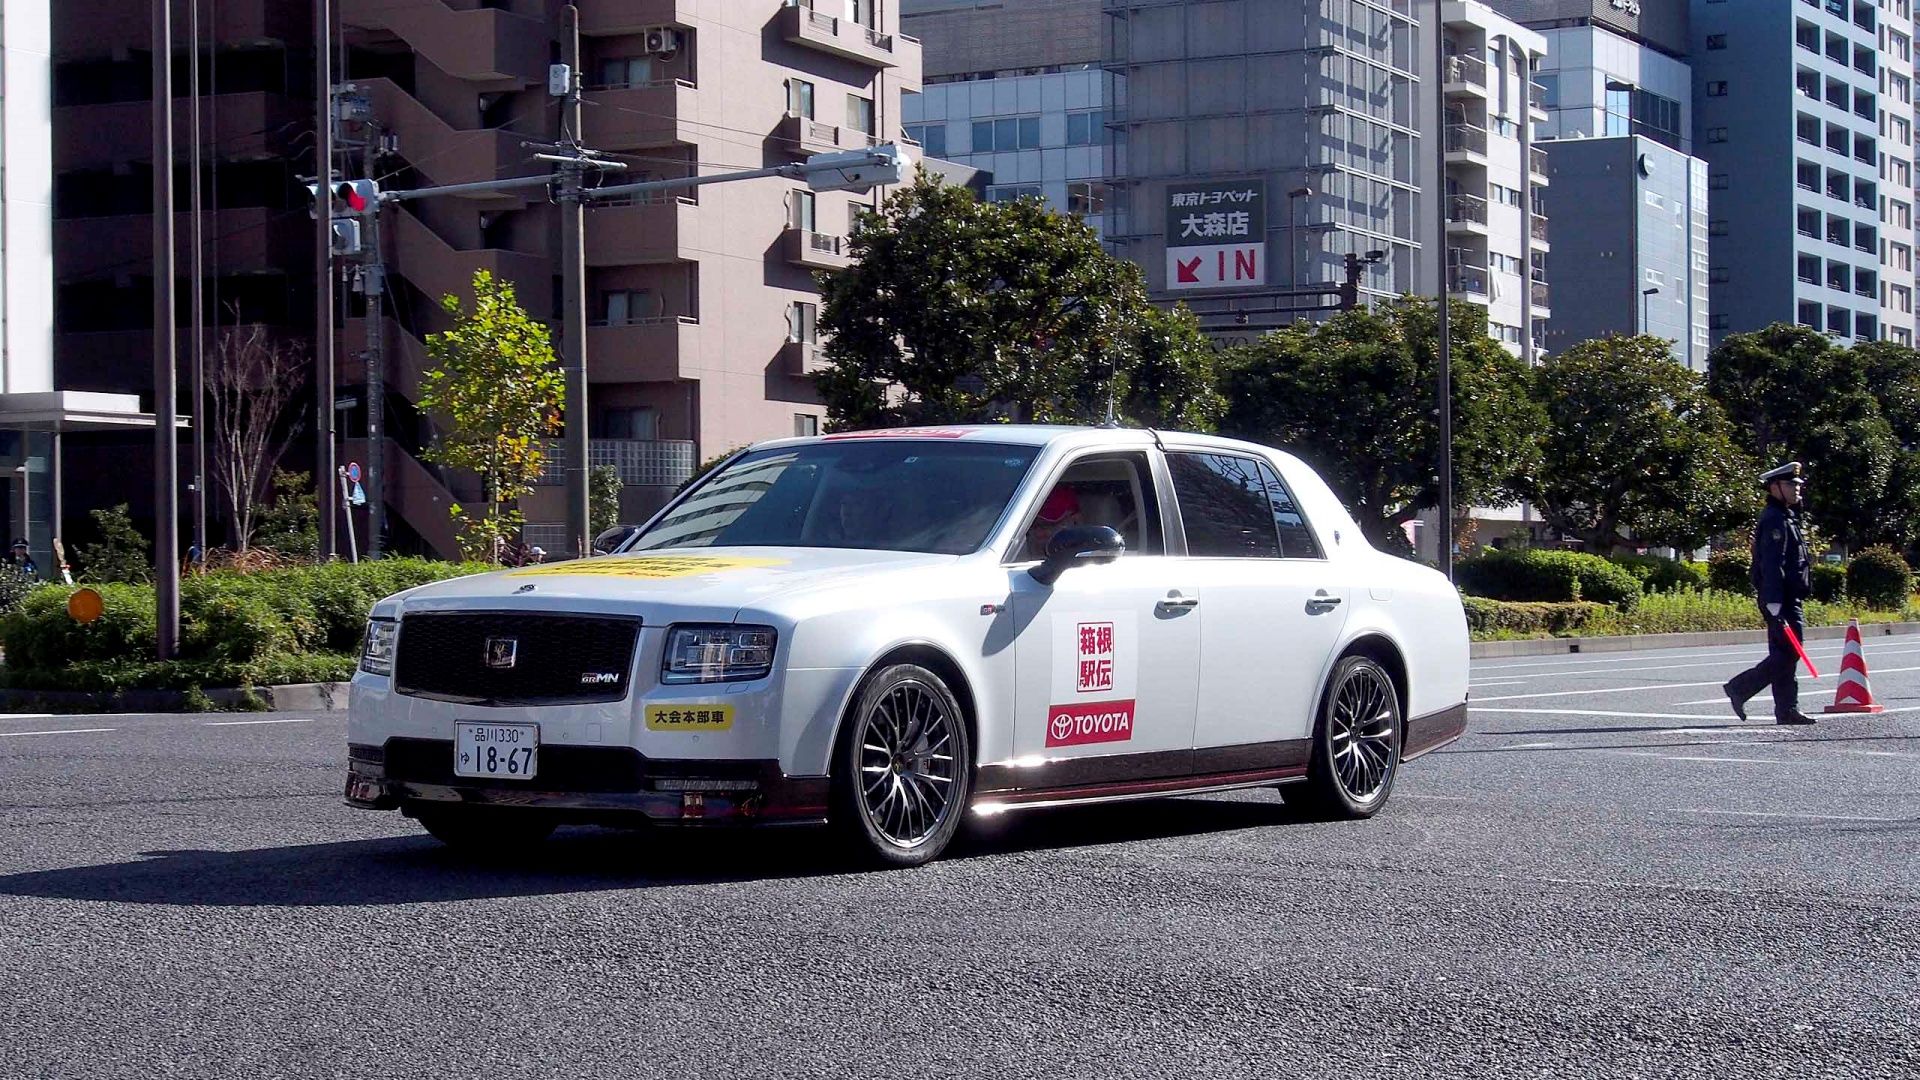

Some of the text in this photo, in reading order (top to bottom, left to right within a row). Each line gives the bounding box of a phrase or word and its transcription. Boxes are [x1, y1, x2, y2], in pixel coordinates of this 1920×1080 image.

[1171, 189, 1259, 207] 東京トヨペット
[1180, 211, 1250, 238] 大森店
[1218, 249, 1256, 281] IN
[1079, 626, 1112, 655] 箱根
[1079, 659, 1112, 688] 駅伝
[654, 710, 725, 724] 大会本部車
[1074, 712, 1129, 735] TOYOTA
[476, 745, 533, 775] 18-67
